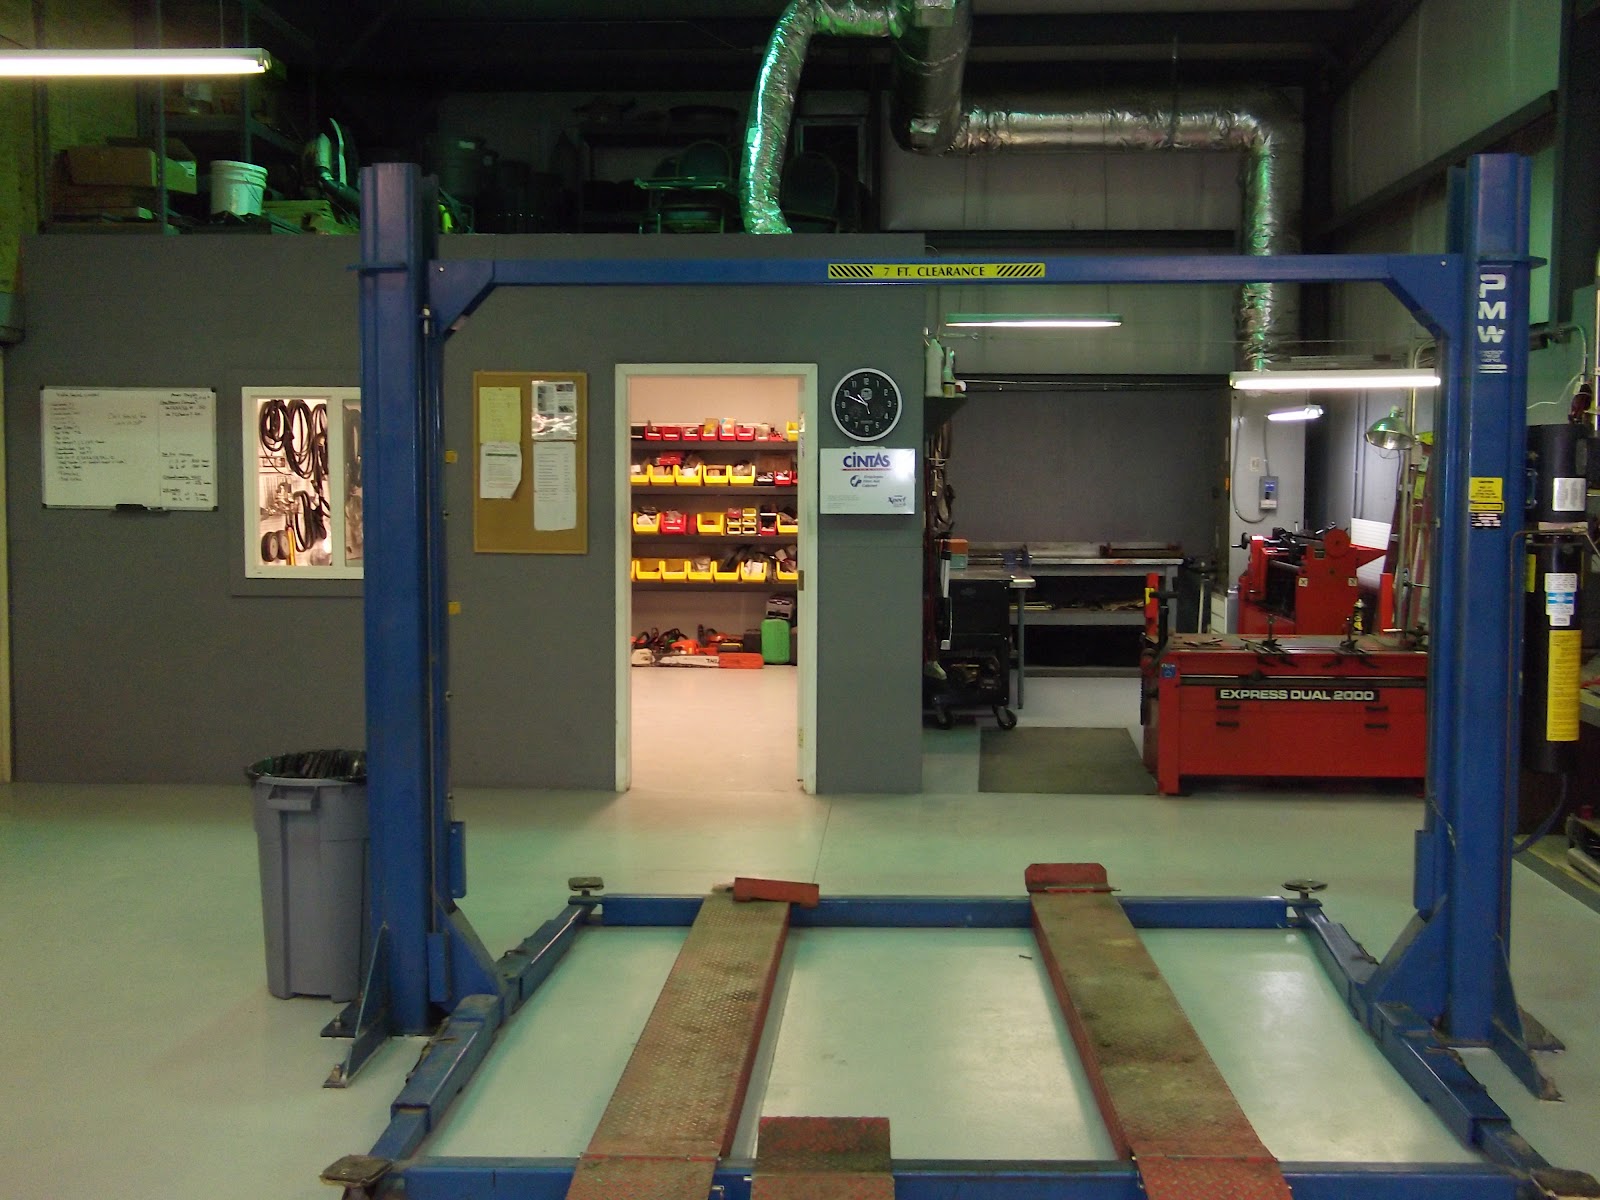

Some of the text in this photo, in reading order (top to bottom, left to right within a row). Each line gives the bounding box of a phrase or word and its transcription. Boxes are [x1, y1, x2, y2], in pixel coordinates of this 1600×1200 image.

[883, 266, 985, 277] 7 FT. CLEARANCE
[1477, 273, 1507, 344] PMW
[843, 451, 891, 468] CINTAS
[1220, 689, 1375, 701] EXPRESS DUAL 2000
